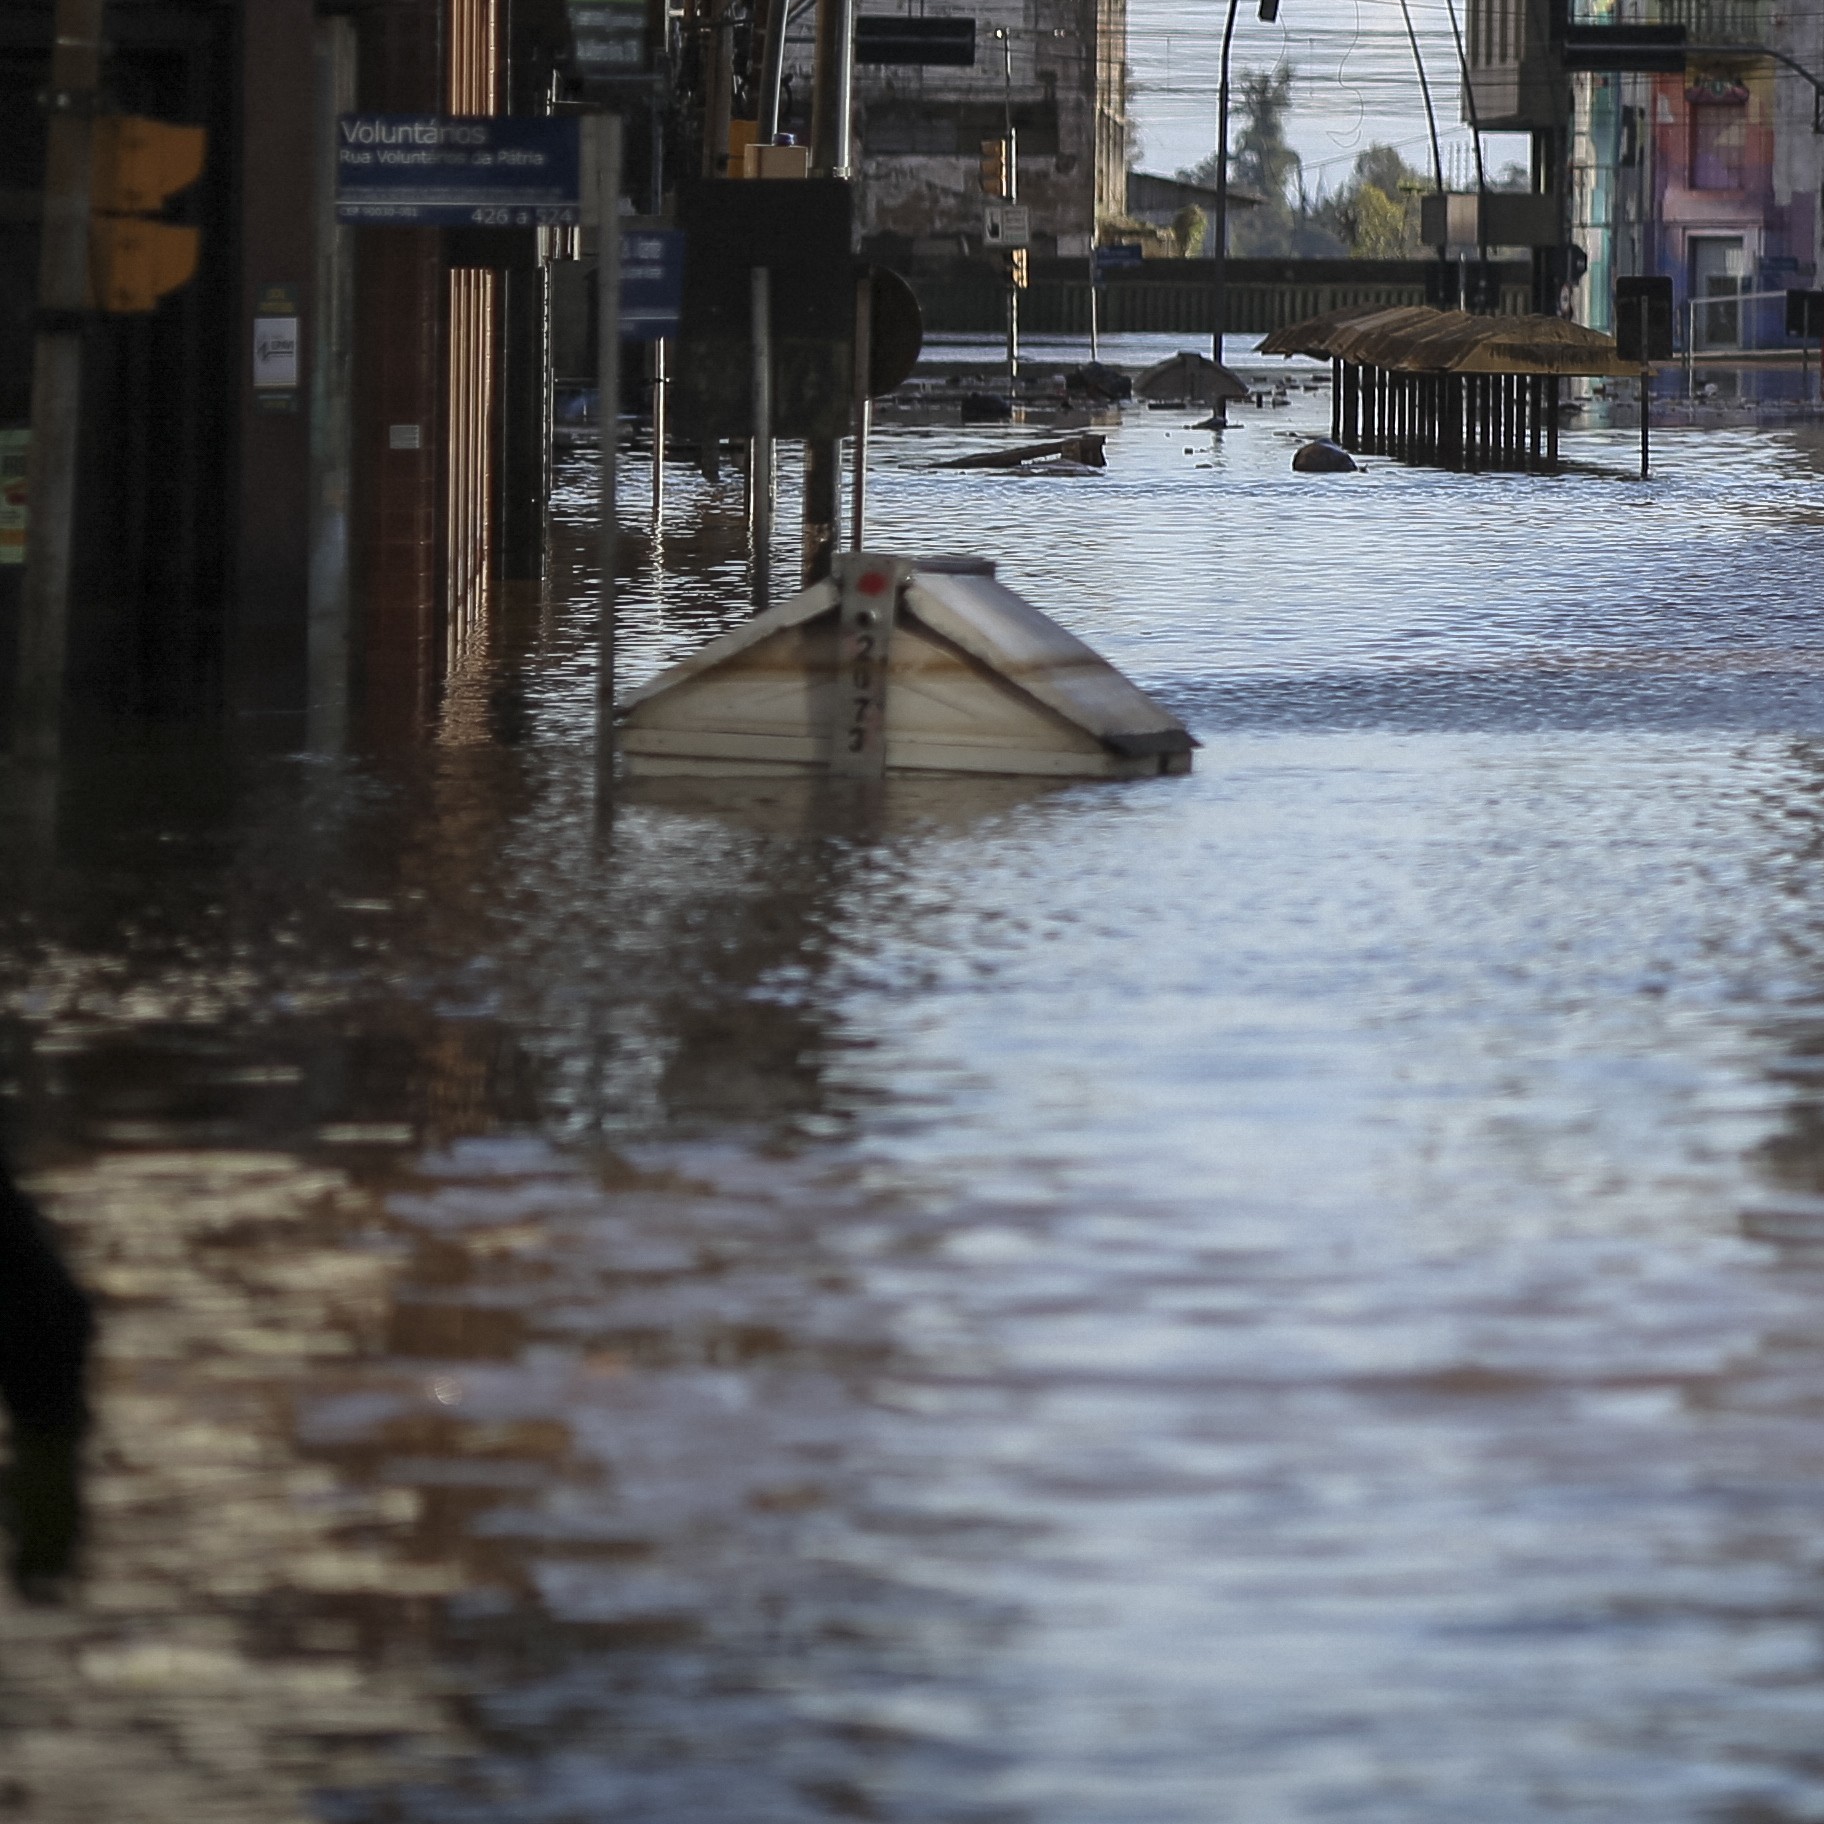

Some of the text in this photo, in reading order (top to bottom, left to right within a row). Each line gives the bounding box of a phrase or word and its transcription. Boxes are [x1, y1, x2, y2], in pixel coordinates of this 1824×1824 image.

[340, 118, 486, 145] Voluntários
[339, 150, 370, 164] Rua
[471, 208, 509, 225] 426
[515, 212, 528, 225] a
[536, 208, 573, 225] 524
